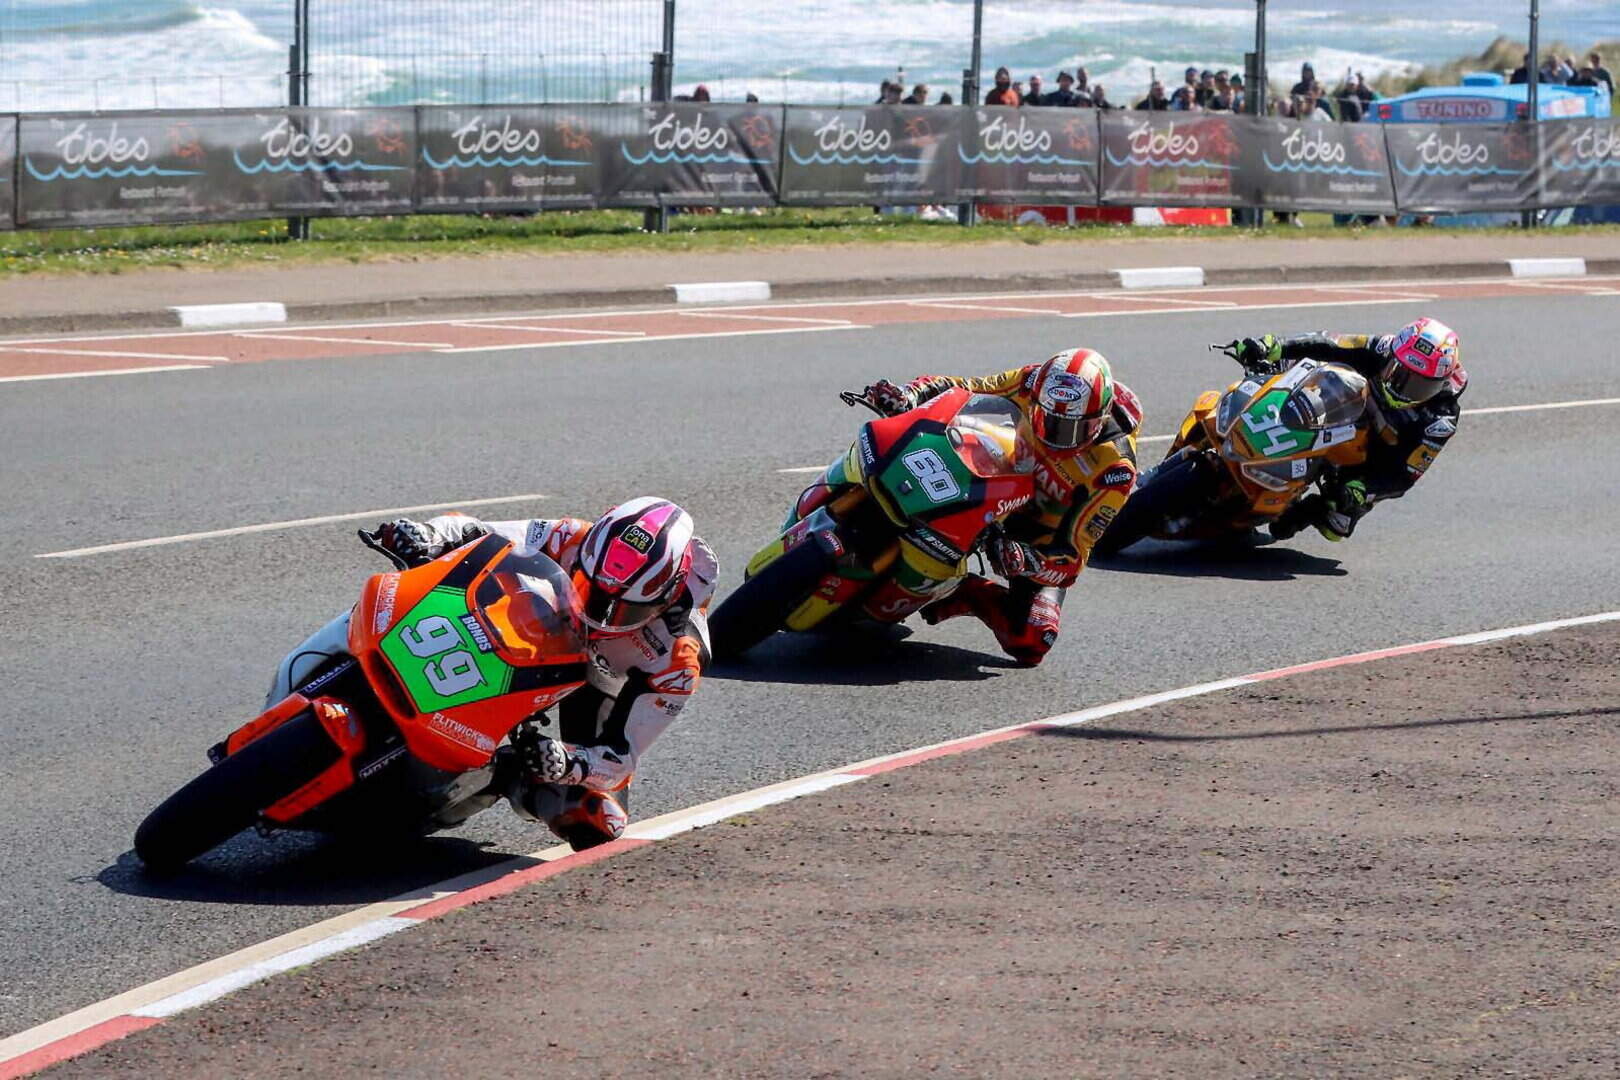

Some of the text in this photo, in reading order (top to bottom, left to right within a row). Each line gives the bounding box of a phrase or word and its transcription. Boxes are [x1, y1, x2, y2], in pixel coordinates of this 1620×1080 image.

[56, 122, 149, 164] tides
[452, 114, 541, 154] tides
[649, 112, 729, 151] tides
[814, 115, 892, 152] tides
[979, 115, 1051, 152] tides
[1128, 120, 1199, 155] tides
[1282, 127, 1346, 163] tides
[1416, 130, 1489, 164] tides
[1240, 403, 1298, 457] 34
[902, 448, 961, 503] 60
[996, 494, 1031, 515] SWAN
[624, 532, 648, 551] CAB
[460, 615, 492, 652] BONDS
[398, 614, 489, 697] 99
[432, 711, 483, 743] FLITWICK
